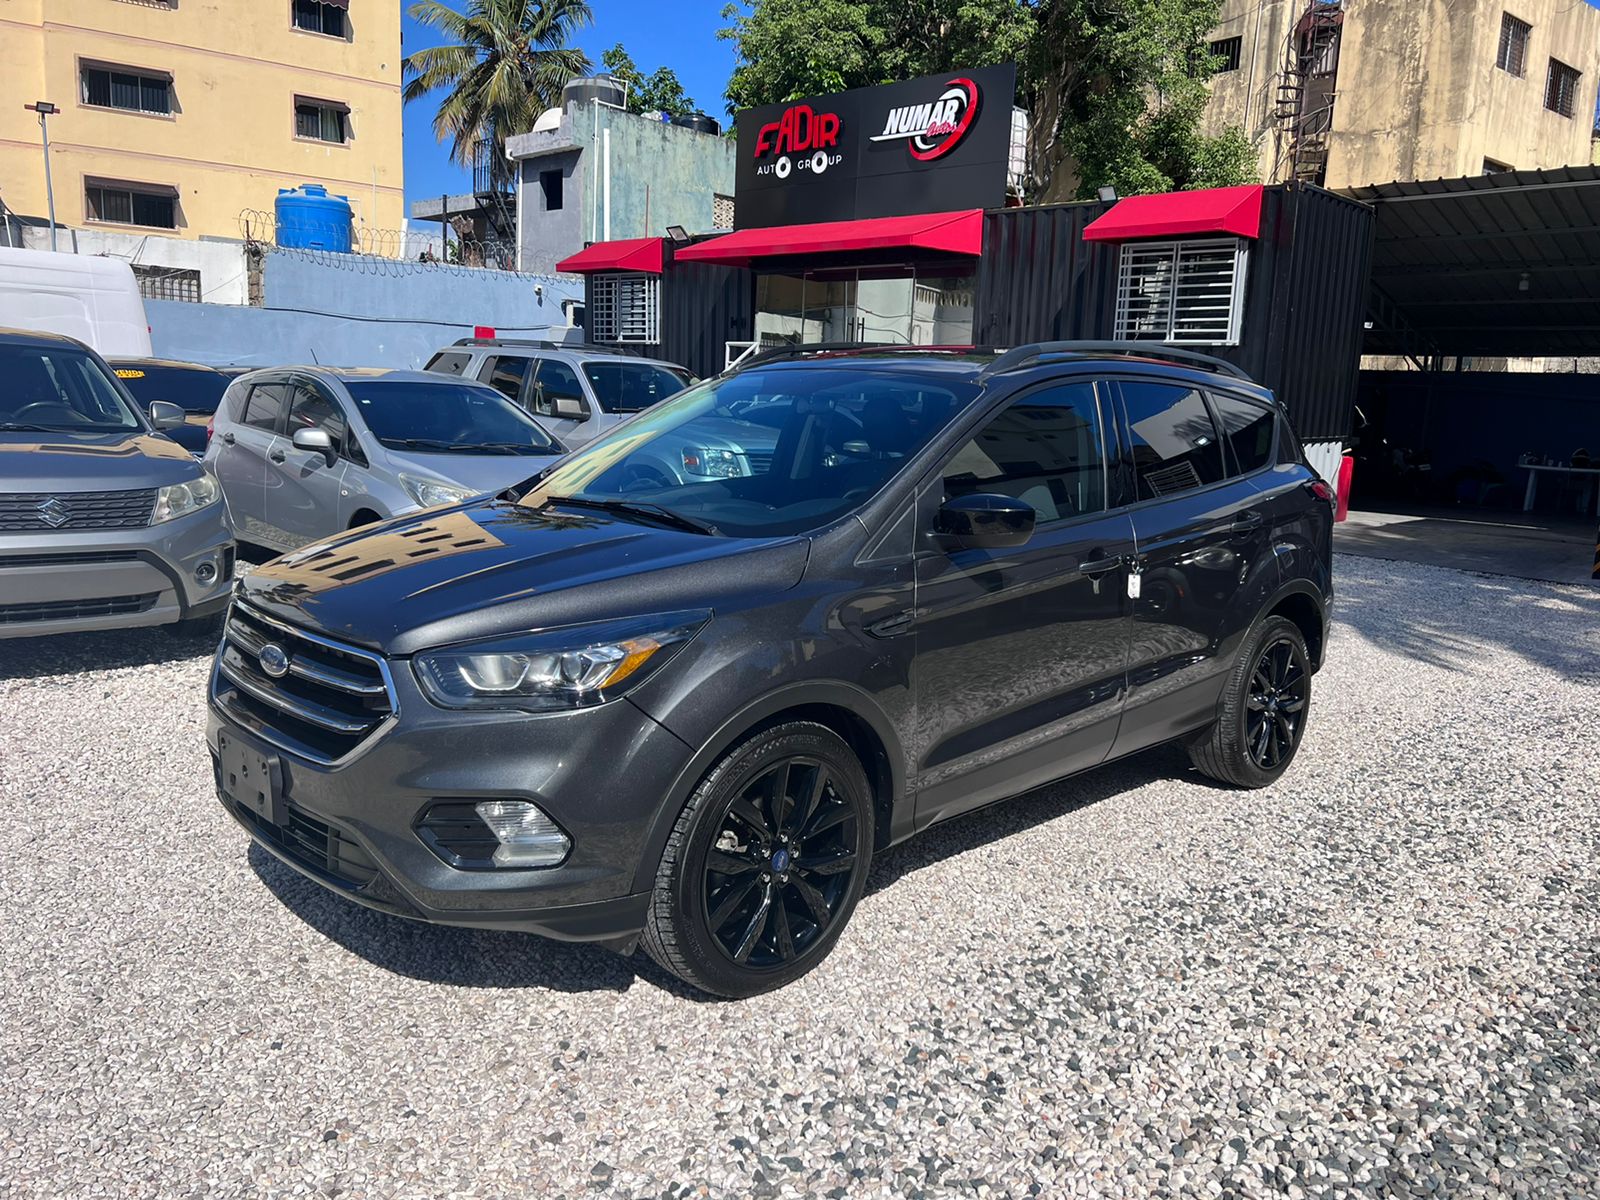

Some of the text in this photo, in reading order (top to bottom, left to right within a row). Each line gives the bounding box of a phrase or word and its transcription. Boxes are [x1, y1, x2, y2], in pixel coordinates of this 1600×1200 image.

[754, 105, 840, 158] FADIR
[882, 99, 959, 135] NUMAR
[757, 151, 842, 178] AUTO GROUP
